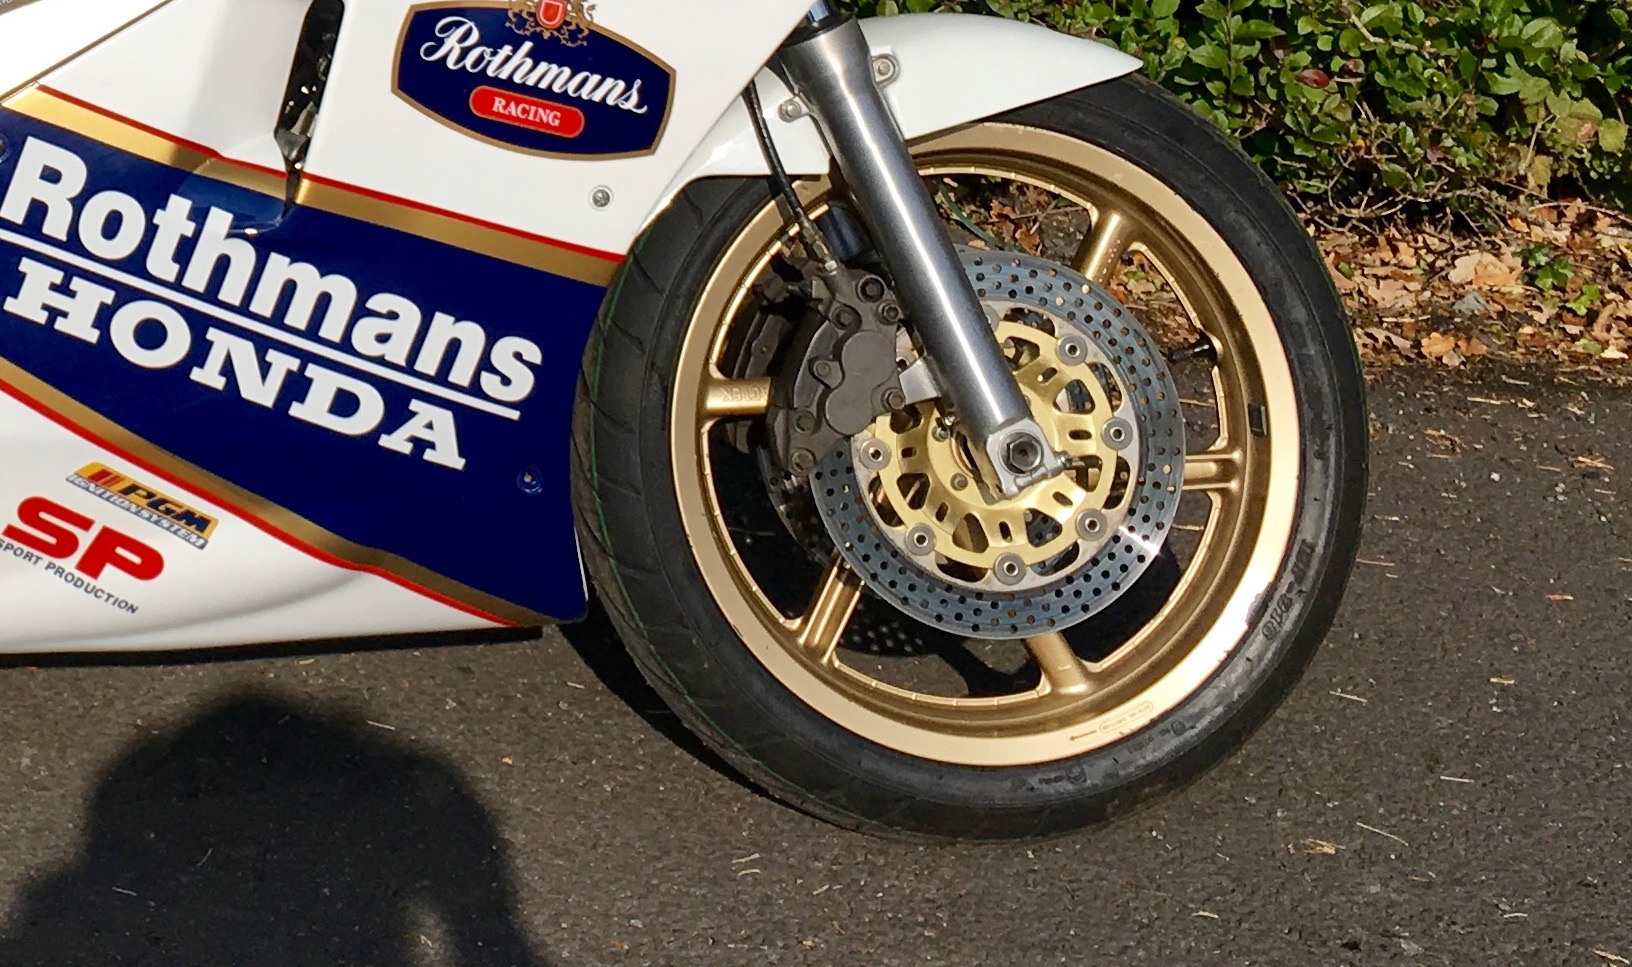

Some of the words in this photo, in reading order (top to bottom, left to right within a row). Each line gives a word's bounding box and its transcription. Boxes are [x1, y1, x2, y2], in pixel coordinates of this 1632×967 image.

[419, 15, 649, 114] Rothmans
[491, 95, 562, 128] RACING
[3, 256, 465, 470] HONDA
[1, 495, 165, 581] SP
[120, 482, 211, 533] PGM
[44, 560, 139, 614] PRODUCTION
